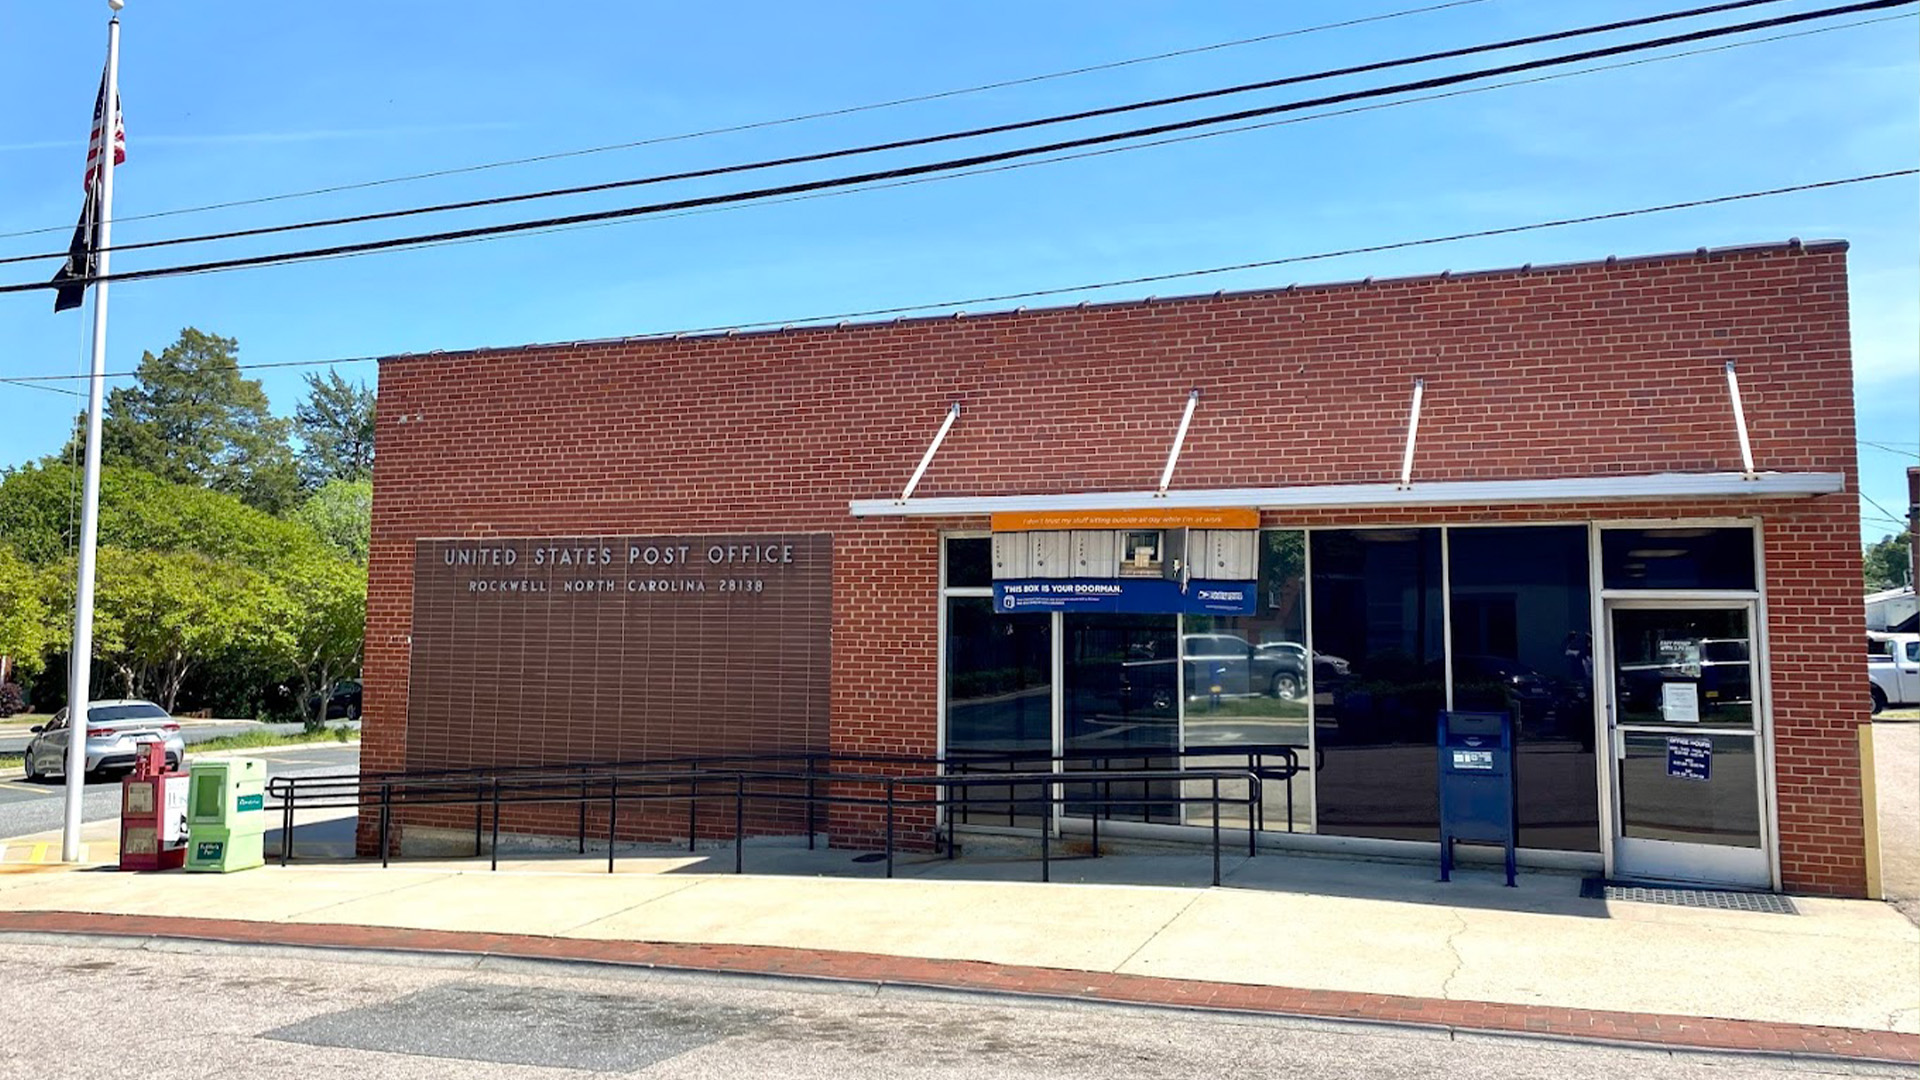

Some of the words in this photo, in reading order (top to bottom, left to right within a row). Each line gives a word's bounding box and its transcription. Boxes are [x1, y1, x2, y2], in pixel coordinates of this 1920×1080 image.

[444, 548, 517, 565] UNITED
[534, 547, 612, 565] STATES
[629, 546, 690, 565] POST
[708, 545, 794, 563] OFFICE
[468, 580, 547, 592] ROCKWELL
[564, 580, 616, 592] NORTH
[628, 579, 706, 592] CAROLINA
[719, 579, 765, 592] 28138
[1004, 585, 1022, 593] THIS
[1024, 585, 1040, 593] BOX
[1041, 585, 1050, 593] IS
[1051, 585, 1074, 593] YOUR
[1075, 585, 1123, 594] DOORMAN.
